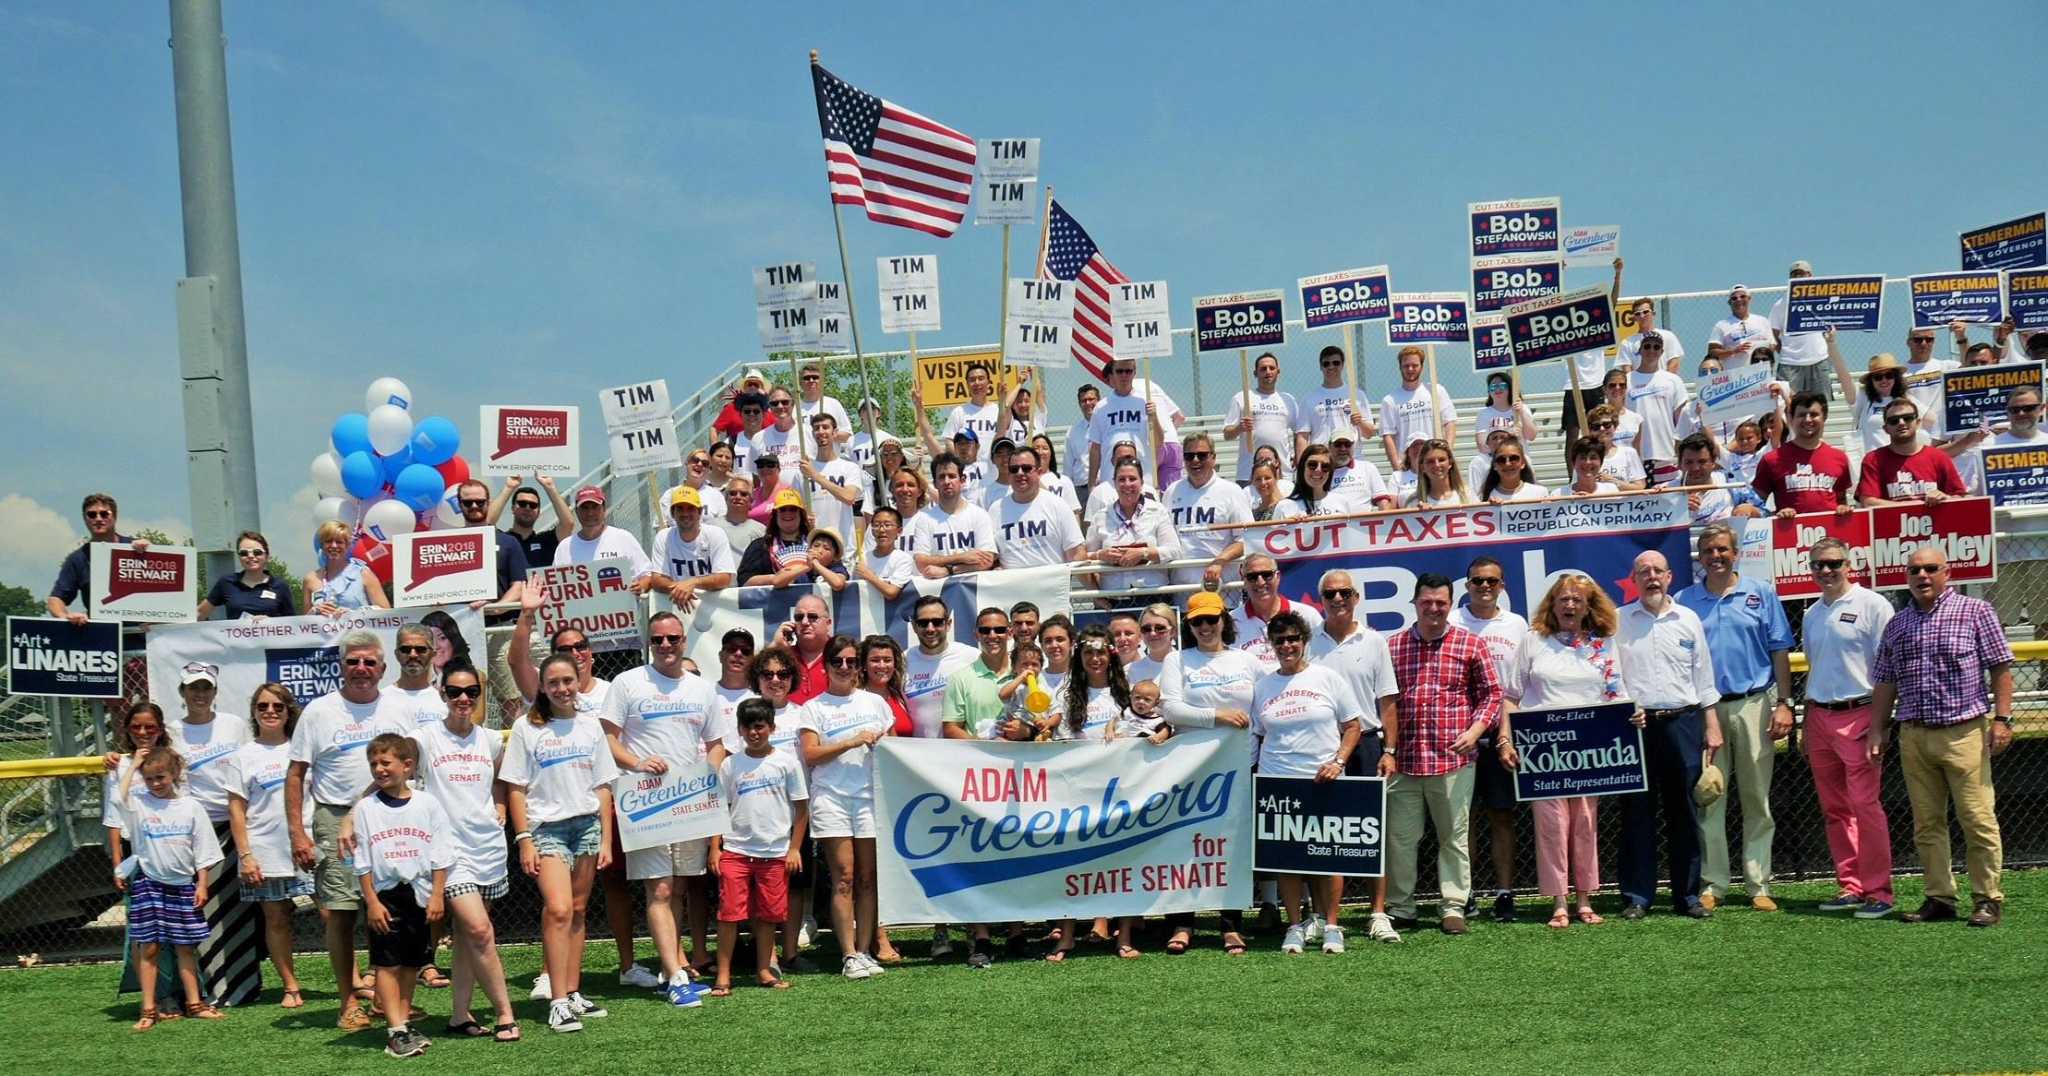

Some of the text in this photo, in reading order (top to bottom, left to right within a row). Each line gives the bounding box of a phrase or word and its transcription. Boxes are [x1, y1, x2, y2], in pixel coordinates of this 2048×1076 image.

[992, 141, 1026, 159] TIM
[990, 184, 1024, 201] TIM
[1490, 213, 1540, 234] Bob
[1475, 231, 1556, 244] STEFANOWSKI
[1963, 218, 2044, 248] STEMERMAN
[1988, 239, 2043, 258] GOVERNOR
[766, 264, 802, 286] TIM
[890, 258, 924, 274] TIM
[1492, 268, 1542, 289] Bob
[1914, 277, 1998, 294] STEMERMAN
[820, 284, 838, 298] IM
[1024, 282, 1061, 300] TIM
[1122, 284, 1155, 300] TIM
[1320, 282, 1371, 305] Bob
[1477, 286, 1559, 300] STEFANOWSKI
[1792, 282, 1880, 298] STEMERMAN
[893, 295, 926, 311] TIM
[1308, 298, 1388, 318] STEFANOWSKI
[1534, 296, 1562, 309] TAXES
[1816, 302, 1876, 311] GOVERNOR
[1916, 296, 1998, 308] FOR GOVERNOR
[2012, 298, 2034, 306] FOR
[770, 308, 806, 328] TIM
[1215, 305, 1265, 328] Bob
[1404, 304, 1452, 322] Bob
[1530, 307, 1590, 337] Bob
[820, 320, 838, 334] IM
[1020, 324, 1058, 344] TIM
[1124, 321, 1158, 339] TIM
[1200, 324, 1281, 340] STEFANOWSKI
[1391, 322, 1466, 332] STEFANOWSKI
[1516, 322, 1610, 352] STEFANOWSKI
[924, 358, 1011, 380] VISING
[1947, 369, 2040, 392] STEMERMAN
[614, 384, 654, 408] TIM
[945, 381, 994, 400] FAS
[1949, 396, 2007, 408] FOR GOVE
[966, 420, 998, 432] TIM
[1107, 410, 1142, 426] TIM
[506, 426, 560, 436] STEWART
[622, 428, 664, 450] TIM
[1987, 452, 2048, 470] STEMER
[1990, 478, 2014, 488] FOR
[1172, 506, 1216, 524] TIM
[1507, 500, 1659, 522] VOTE AUGUST 14TH
[1002, 520, 1046, 540] TIM
[1507, 512, 1673, 533] REPUBLICAN PRIMARY
[1900, 513, 1932, 538] Joe
[934, 531, 976, 550] TIM
[1264, 510, 1496, 554] CUT TAXES
[1796, 524, 1827, 548] Joe
[420, 551, 476, 565] STEWART
[672, 558, 712, 576] TIM
[118, 569, 178, 581] STEWART
[1776, 576, 1814, 584] LIEUTENA
[1876, 567, 1908, 575] LIEUTE
[540, 602, 565, 620] CT
[300, 624, 318, 634] WE
[544, 611, 636, 638] AROUND!
[19, 632, 42, 648] Art
[12, 648, 118, 673] LINARES
[56, 672, 118, 683] State Treasurer
[280, 662, 342, 680] ERIN20
[280, 678, 344, 696] STEWA
[1547, 711, 1596, 723] Re-Elect
[1515, 728, 1577, 744] Noreen
[432, 754, 493, 768] GREENBERG
[1516, 737, 1640, 774] Kokoruda
[448, 774, 481, 782] SENATE
[638, 778, 662, 791] ADAM
[960, 768, 1048, 802] ADAM
[1534, 773, 1642, 791] State Representative
[620, 774, 717, 813] Greenberg
[708, 792, 718, 800] for
[672, 800, 720, 816] STATE SENATE
[1266, 794, 1290, 813] Art
[894, 769, 1237, 860] Greenberg
[1258, 812, 1380, 844] LINARES
[384, 849, 420, 860] SENATE
[1193, 834, 1226, 858] for
[1307, 844, 1380, 857] State Treasurer
[1065, 862, 1227, 896] STATE SENATE
